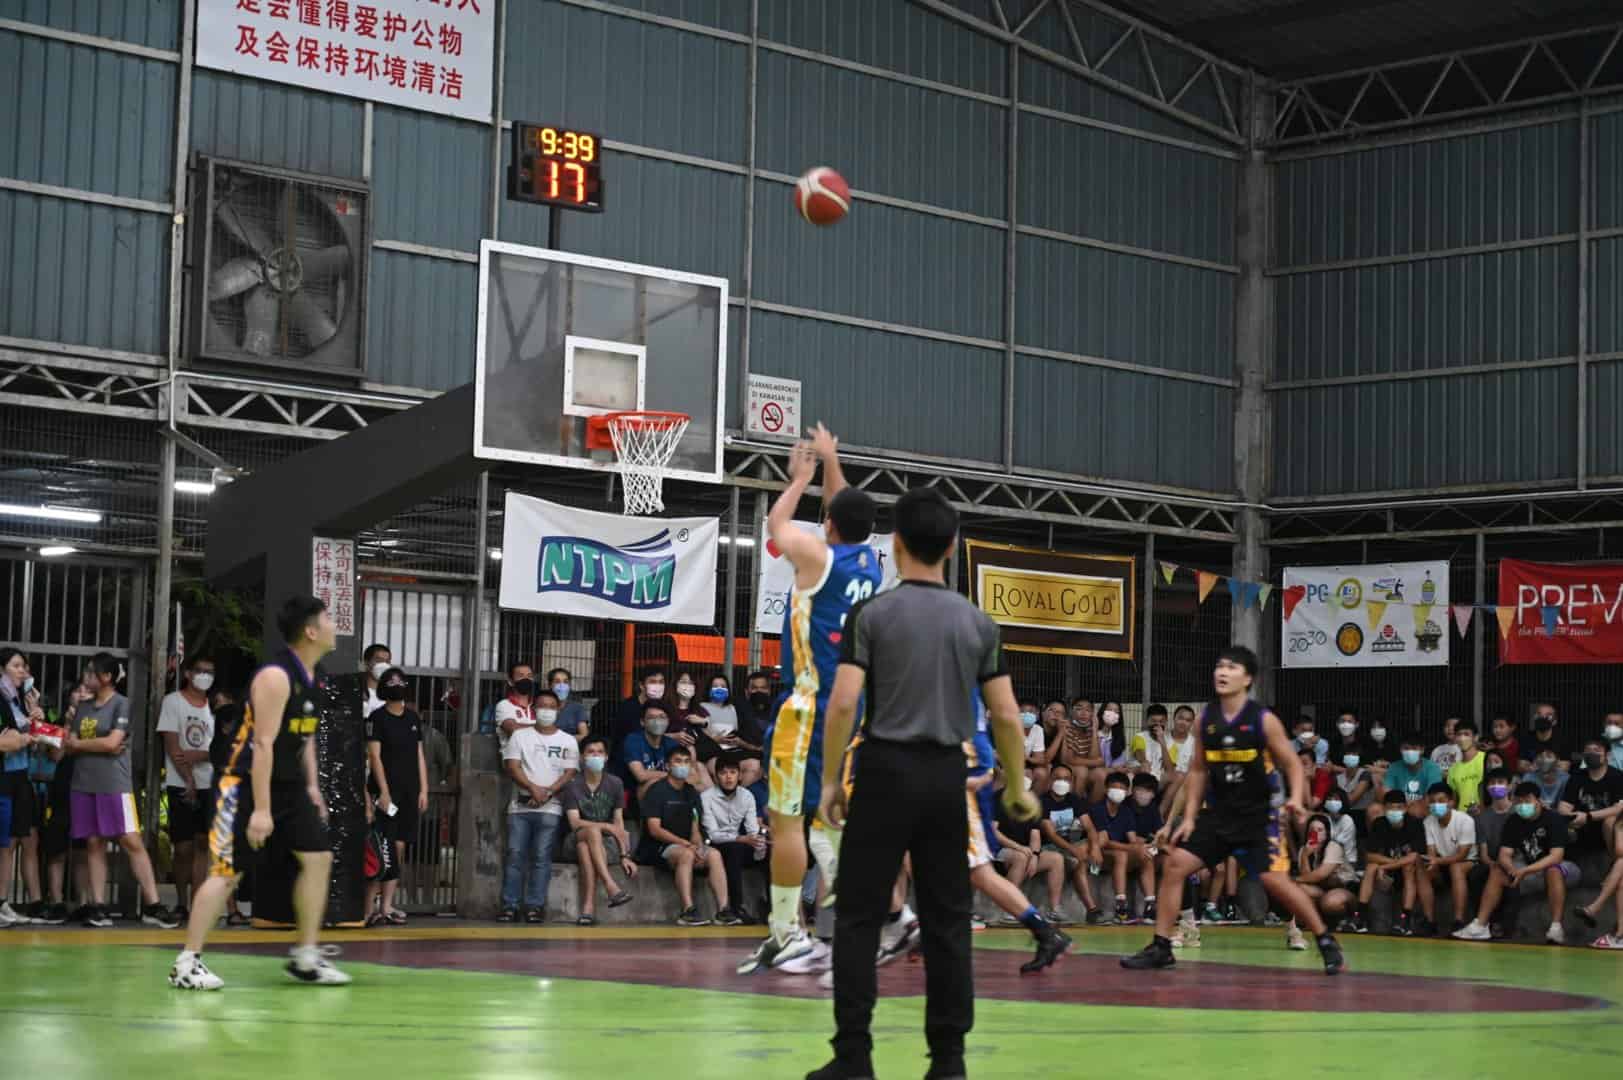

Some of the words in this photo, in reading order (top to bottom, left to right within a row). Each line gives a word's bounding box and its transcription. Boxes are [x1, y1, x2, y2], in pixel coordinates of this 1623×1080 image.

[235, 25, 463, 99] 及会保持环境清洁
[541, 128, 594, 162] 9:39
[551, 161, 584, 203] 17
[314, 542, 333, 620] 保持清
[541, 542, 675, 605] NTPM
[992, 583, 1055, 616] ROYAL
[1060, 588, 1113, 616] GOLD
